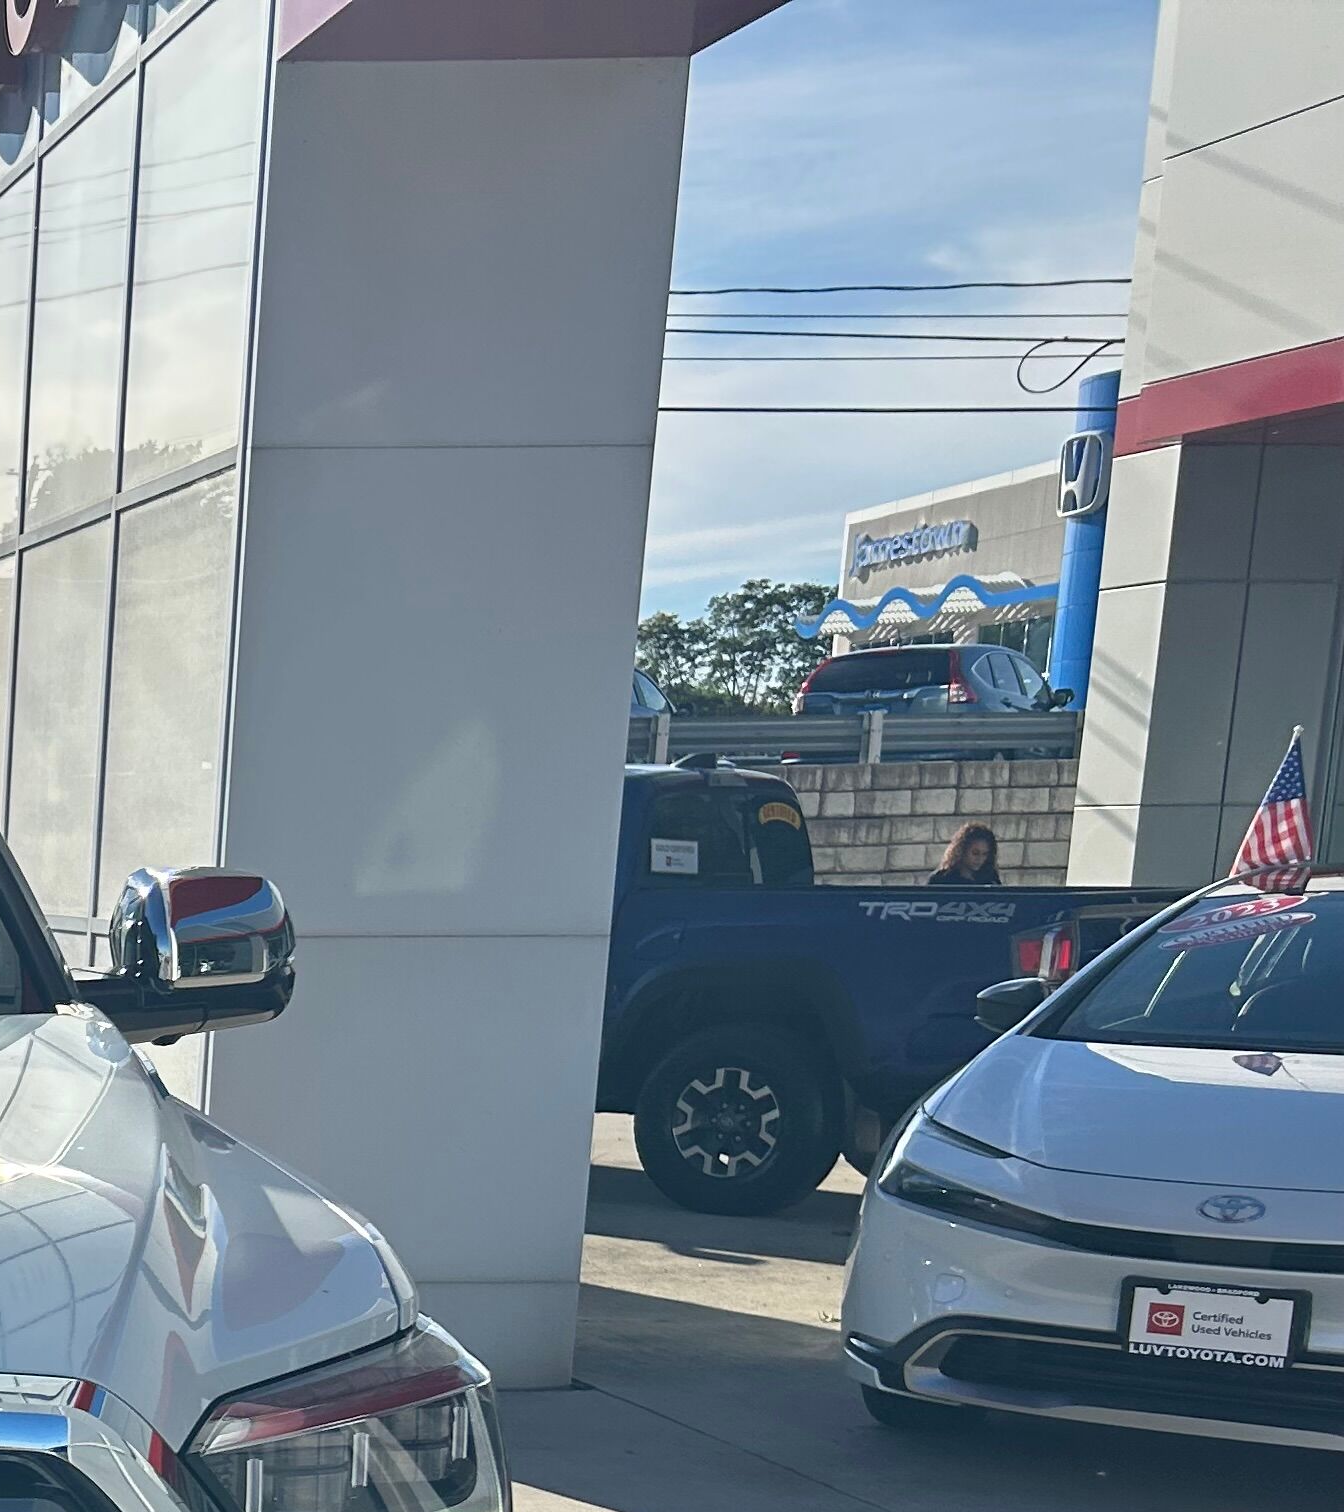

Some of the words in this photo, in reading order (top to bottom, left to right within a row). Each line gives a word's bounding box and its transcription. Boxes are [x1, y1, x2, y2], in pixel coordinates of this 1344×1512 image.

[849, 519, 973, 577] Jamestown
[858, 901, 938, 921] TRD
[936, 915, 963, 923] OFF
[967, 916, 1009, 924] ROAD
[1188, 900, 1281, 929] 2023
[1168, 1283, 1212, 1293] LAKEWOOD
[1193, 1311, 1244, 1325] Certified
[1191, 1324, 1221, 1337] Used
[1224, 1327, 1272, 1341] Vehicles
[1129, 1342, 1285, 1369] LUVTOYOTA.COM
